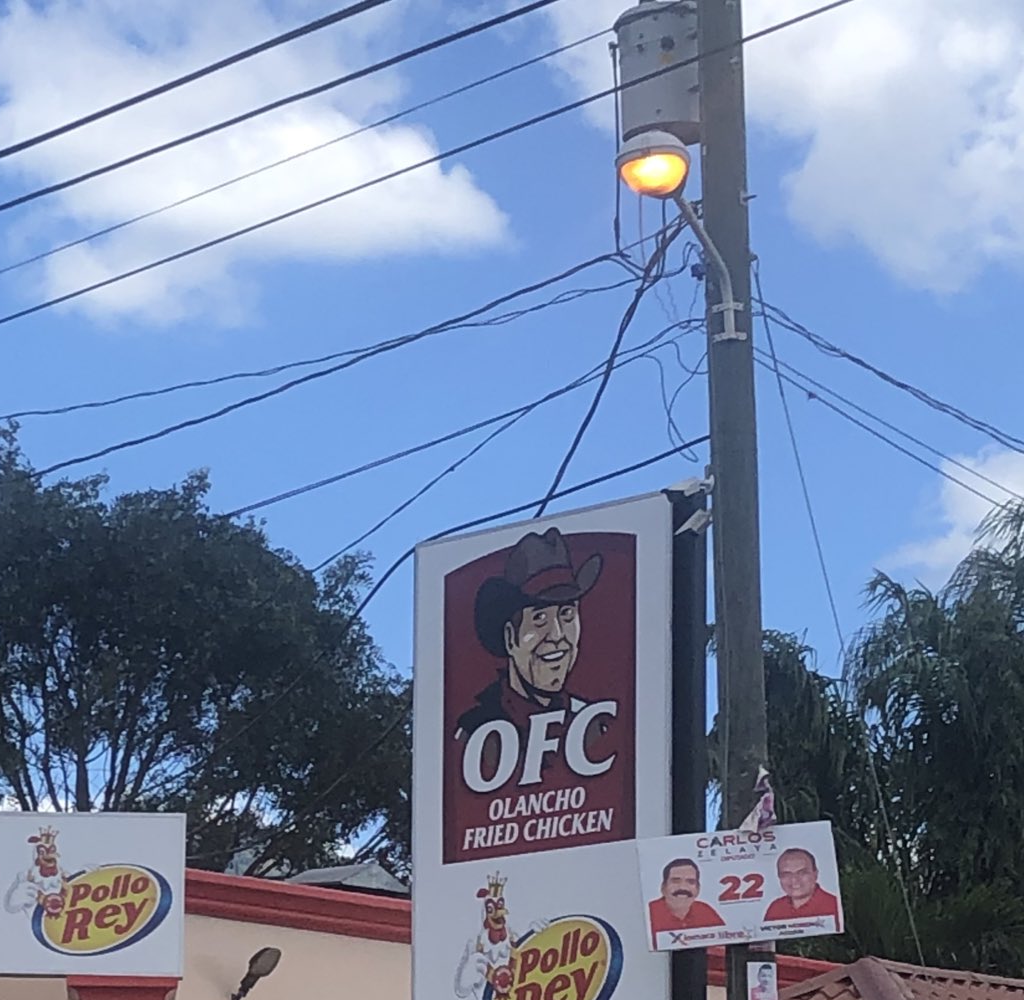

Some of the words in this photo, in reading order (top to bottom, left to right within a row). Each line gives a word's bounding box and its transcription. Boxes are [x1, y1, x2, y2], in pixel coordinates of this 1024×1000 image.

[462, 700, 617, 793] OFC
[489, 786, 586, 821] OLANCHO
[462, 822, 519, 850] FRIED
[523, 808, 614, 841] CHICKEN
[696, 831, 776, 849] CARLOS
[68, 873, 150, 908] Pollo
[718, 873, 765, 902] 22
[61, 898, 149, 944] Rey
[517, 928, 601, 985] Pollo
